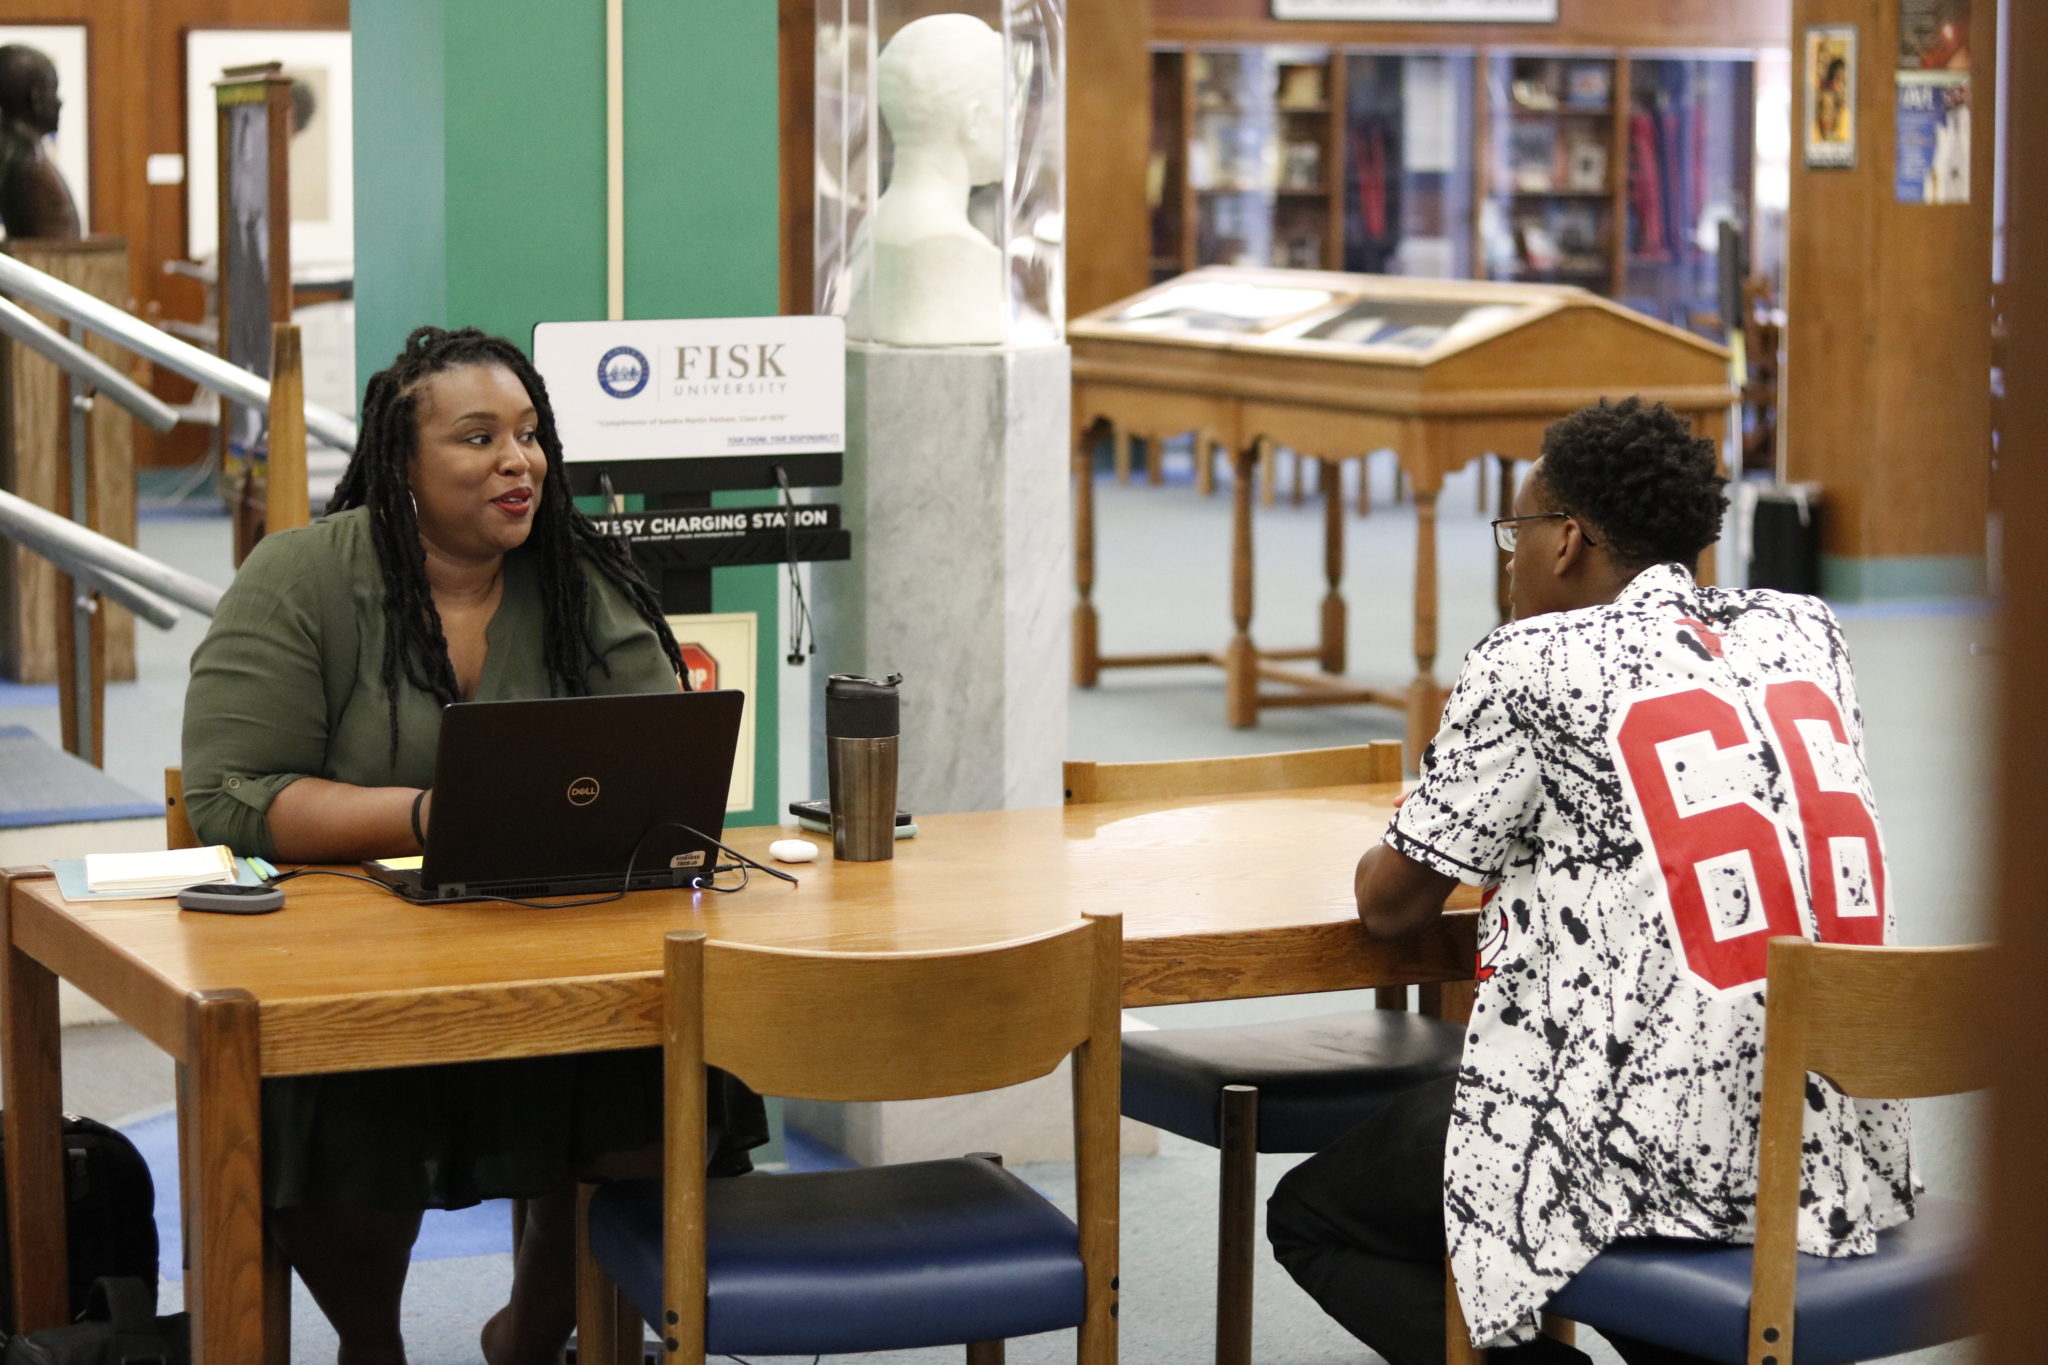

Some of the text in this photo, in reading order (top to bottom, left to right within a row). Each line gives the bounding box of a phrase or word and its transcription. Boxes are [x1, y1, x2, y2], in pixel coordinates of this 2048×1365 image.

[674, 343, 787, 380] FISK
[674, 382, 787, 396] UNIVERSITY
[650, 514, 747, 533] CHARGING
[752, 509, 828, 528] STAION
[571, 787, 597, 796] DELL
[1613, 680, 1888, 994] 66
